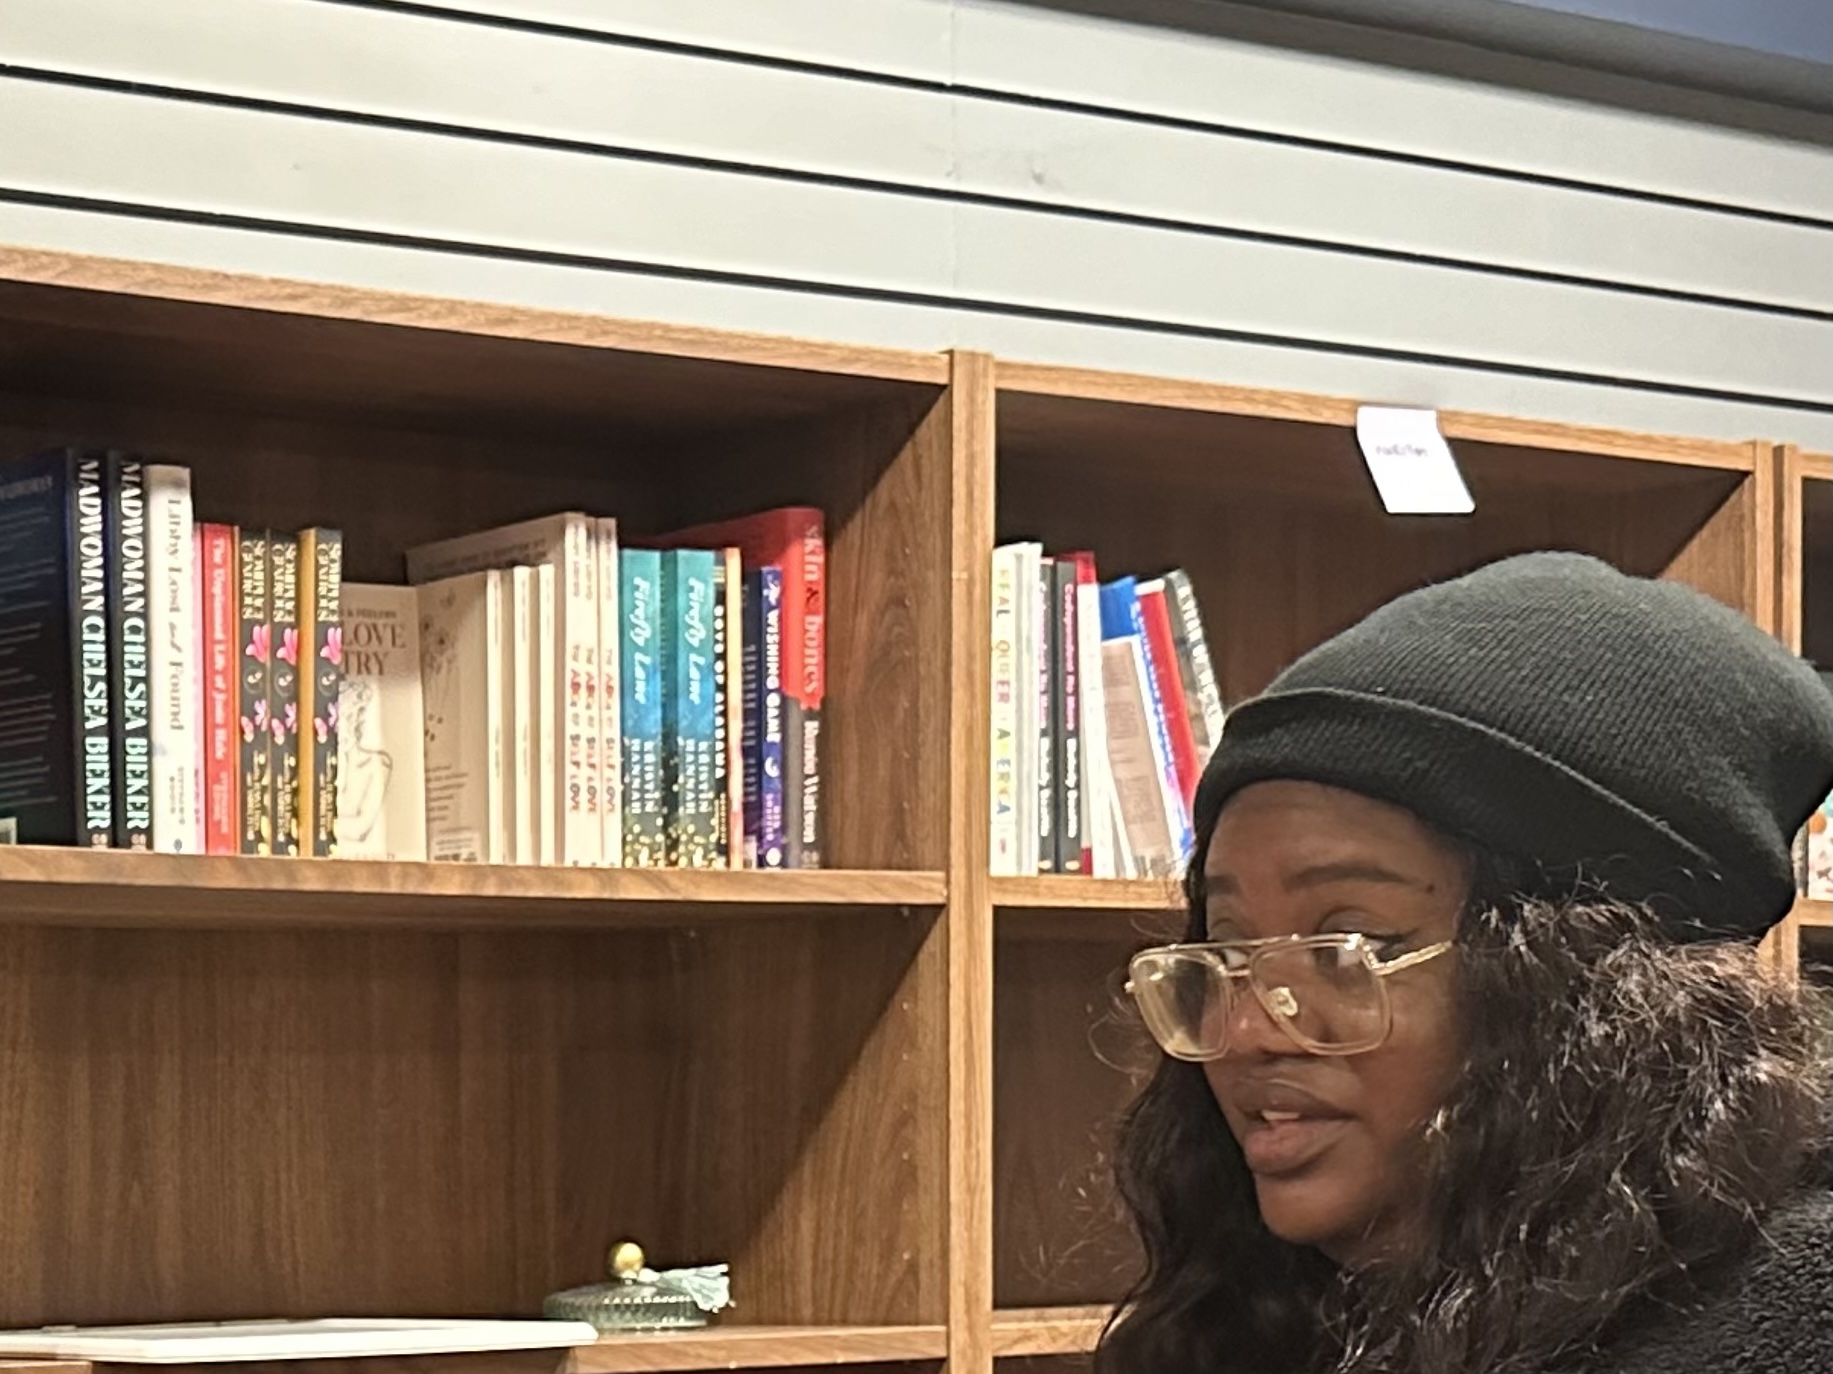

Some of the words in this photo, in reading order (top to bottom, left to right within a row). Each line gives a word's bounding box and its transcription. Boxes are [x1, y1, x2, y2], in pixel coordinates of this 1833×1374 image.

[78, 459, 105, 612] MADWOMAN
[121, 460, 145, 613] MADWOMAN
[629, 576, 652, 647] Firefly
[684, 577, 706, 648] Firefly
[803, 614, 825, 694] bones
[82, 615, 108, 730] CHELSEA
[634, 652, 652, 705] Lane
[689, 653, 706, 705] Lane
[85, 736, 111, 829] BIEKER
[125, 738, 150, 829] BIEKER
